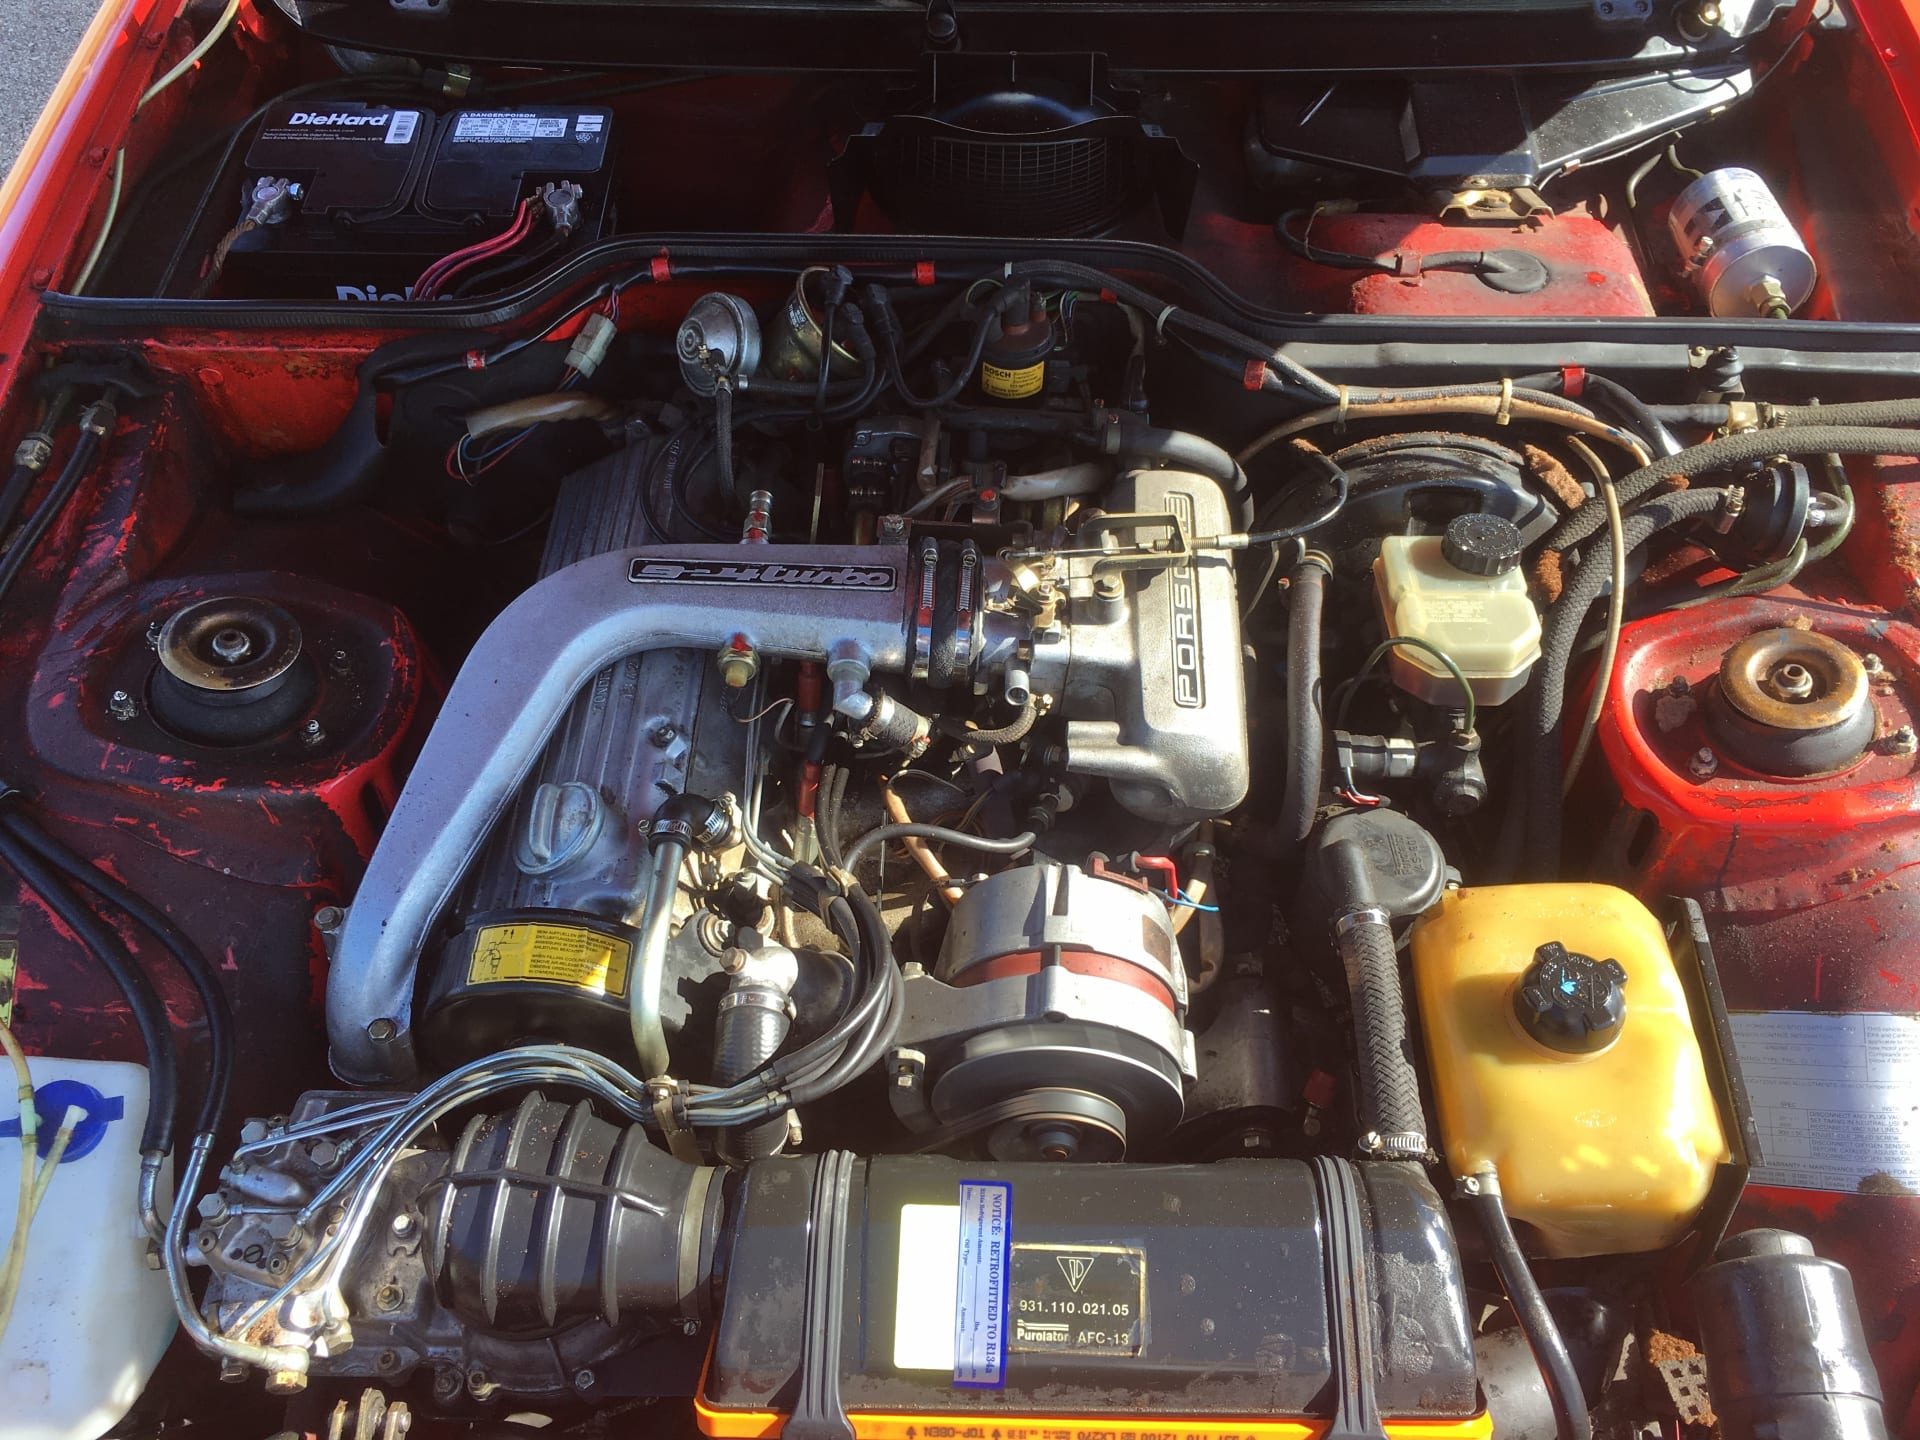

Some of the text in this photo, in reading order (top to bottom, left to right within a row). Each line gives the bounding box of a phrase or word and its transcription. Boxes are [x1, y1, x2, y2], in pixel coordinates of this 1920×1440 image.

[288, 112, 389, 126] DieHard
[984, 365, 1011, 378] BOSCH
[759, 565, 889, 586] turbo
[984, 1193, 1002, 1374] NOTICE: RETROFITTED TO R134a
[1019, 1299, 1129, 1316] 931.110.021.05
[1017, 1327, 1129, 1345] Purolator AFC-13
[924, 1426, 986, 1438] TOP-OBEN
